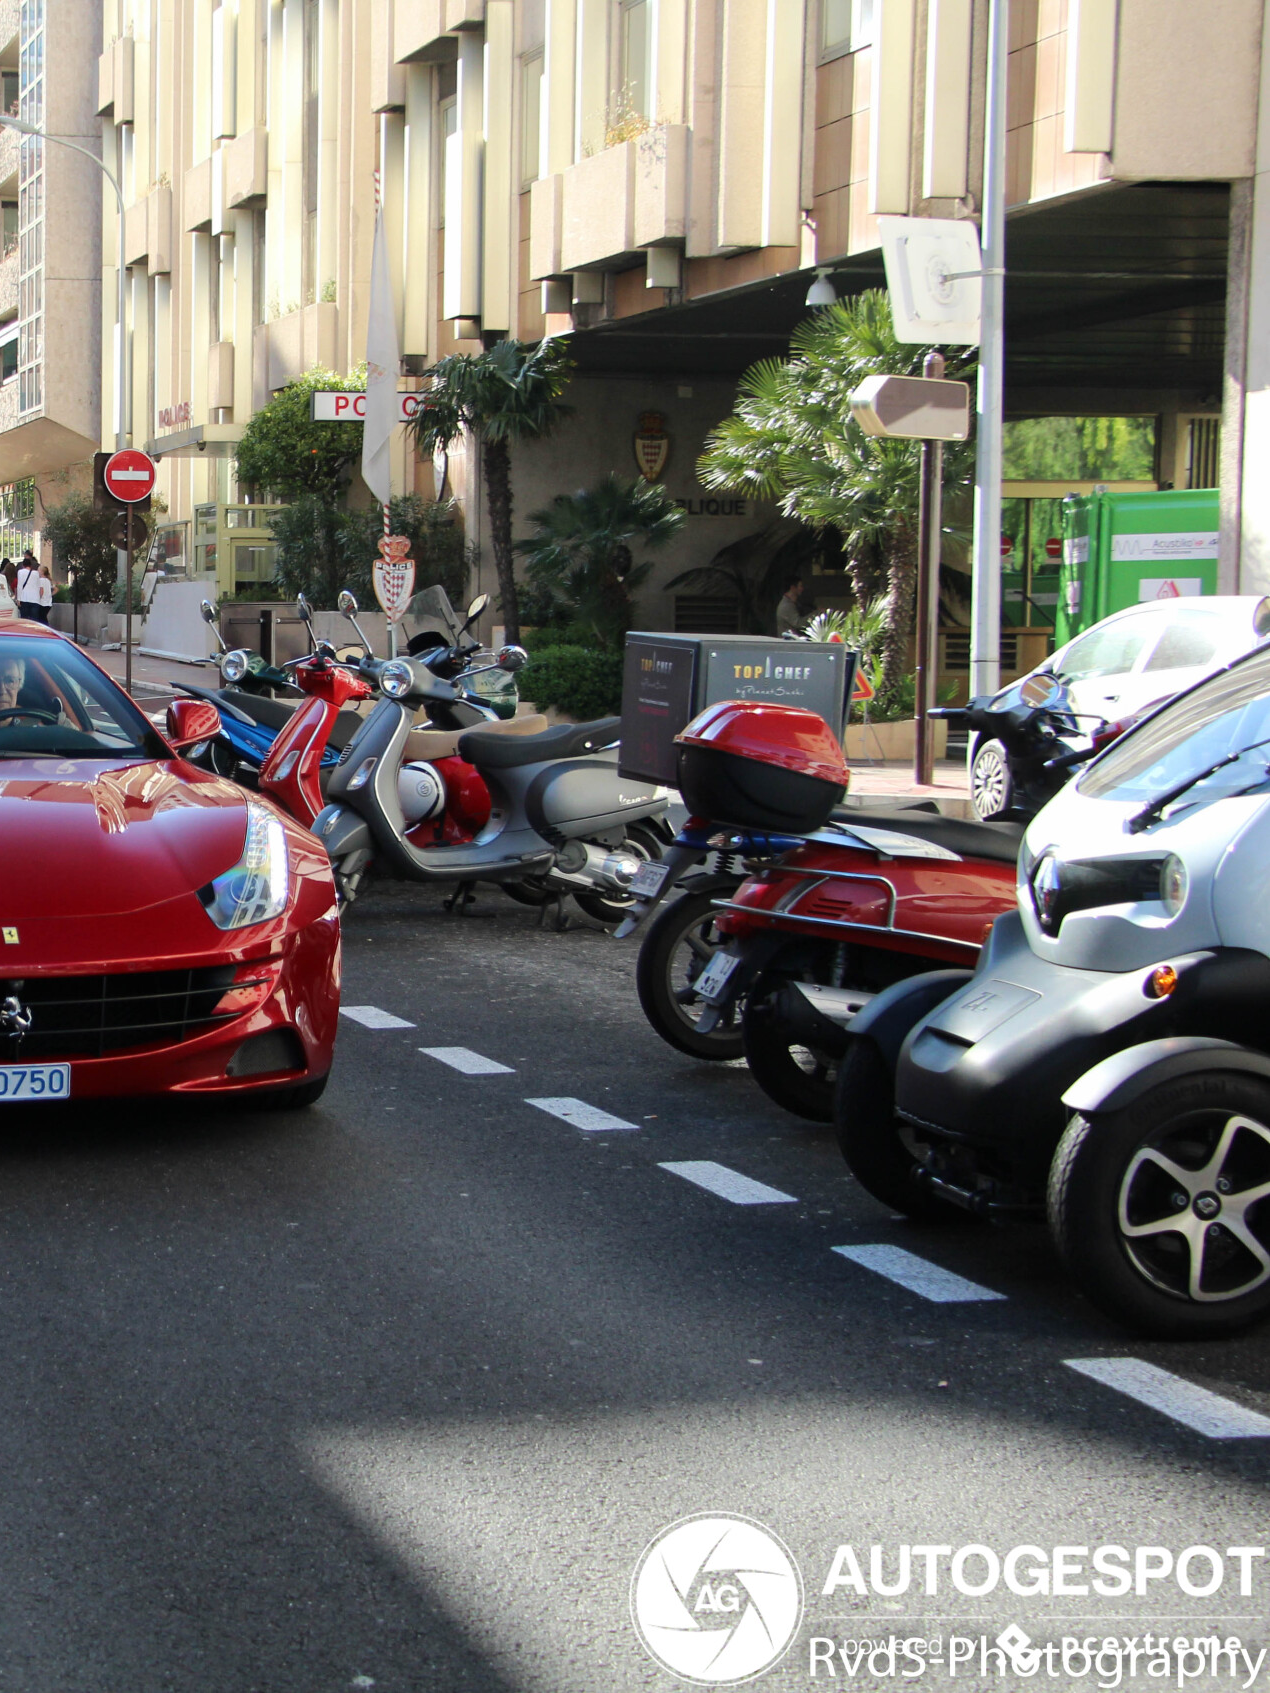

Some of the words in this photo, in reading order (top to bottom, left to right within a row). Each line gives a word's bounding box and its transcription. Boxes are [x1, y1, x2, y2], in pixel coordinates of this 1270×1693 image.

[158, 402, 190, 428] POLICE
[675, 499, 747, 516] BLIQUE
[733, 665, 763, 679] TOP
[774, 666, 811, 680] CHEF
